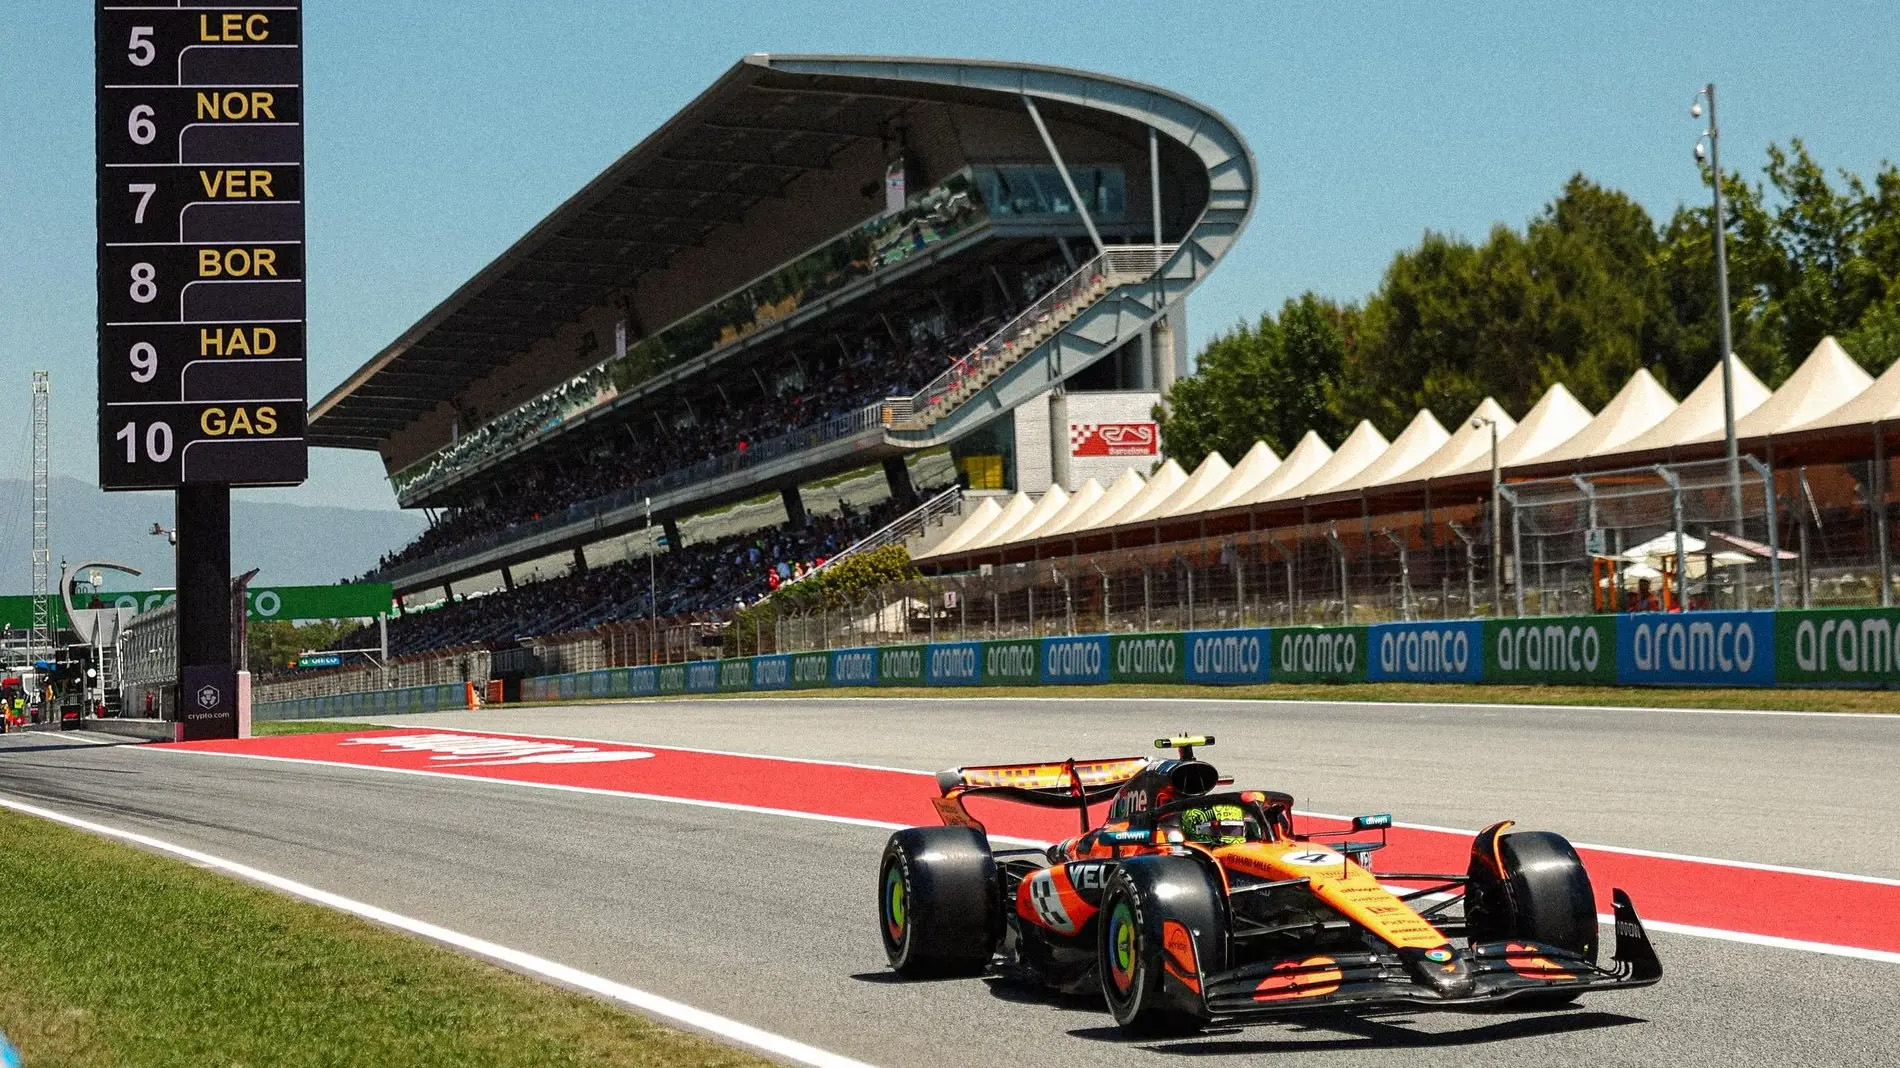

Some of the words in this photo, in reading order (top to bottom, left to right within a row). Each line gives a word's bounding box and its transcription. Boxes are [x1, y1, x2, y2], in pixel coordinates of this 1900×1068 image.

[200, 15, 269, 41] LEC
[127, 27, 156, 67] 5
[197, 92, 275, 120] NOR
[128, 105, 156, 145] 6
[199, 170, 273, 198] VER
[128, 183, 157, 224] 7
[199, 249, 277, 277] BOR
[129, 262, 157, 303] 8
[200, 328, 276, 356] HAD
[129, 342, 158, 383] 9
[200, 406, 278, 436] GAS
[116, 421, 173, 463] 10
[932, 647, 975, 677] aramco
[987, 644, 1034, 677] aramco
[1048, 641, 1100, 675] aramco
[1117, 638, 1176, 674] aramco
[1193, 635, 1260, 674] aramco
[1281, 632, 1355, 673] aramco
[1381, 629, 1468, 673] aramco
[1497, 624, 1598, 673] aramco
[1634, 621, 1755, 673] aramco
[1796, 618, 1900, 672] aram
[836, 653, 871, 680] aramco
[882, 650, 921, 678] aramco
[188, 712, 230, 720] crypto.com
[1294, 853, 1328, 863] 4
